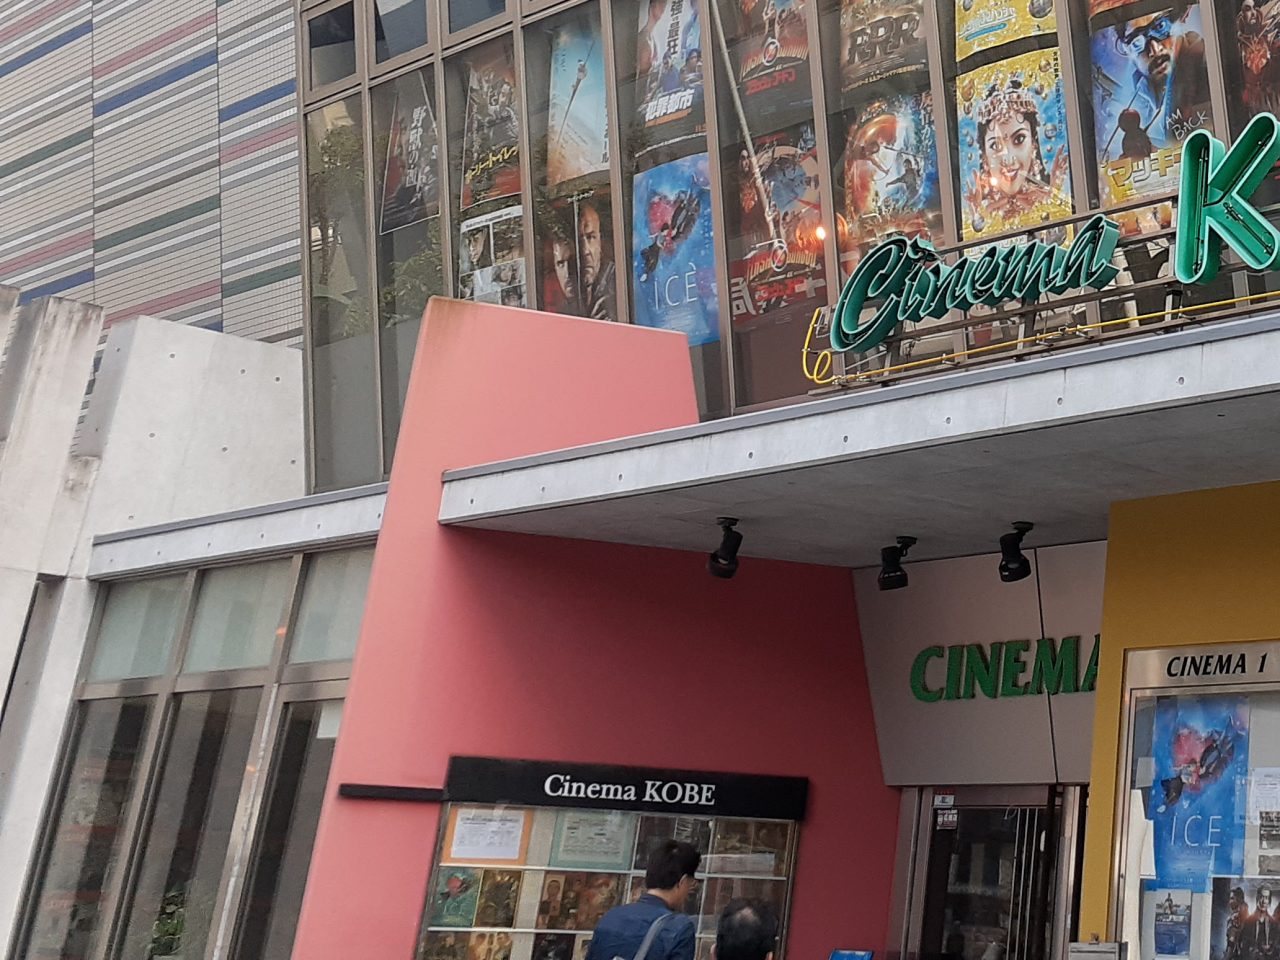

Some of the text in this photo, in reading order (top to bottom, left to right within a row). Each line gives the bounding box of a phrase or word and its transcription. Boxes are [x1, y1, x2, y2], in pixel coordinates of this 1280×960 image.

[847, 13, 920, 66] RRR
[830, 214, 1120, 354] Cinema
[1166, 652, 1268, 678] CINEMA 1
[544, 774, 716, 806] Cinema KOBE
[1170, 814, 1223, 848] ICE
